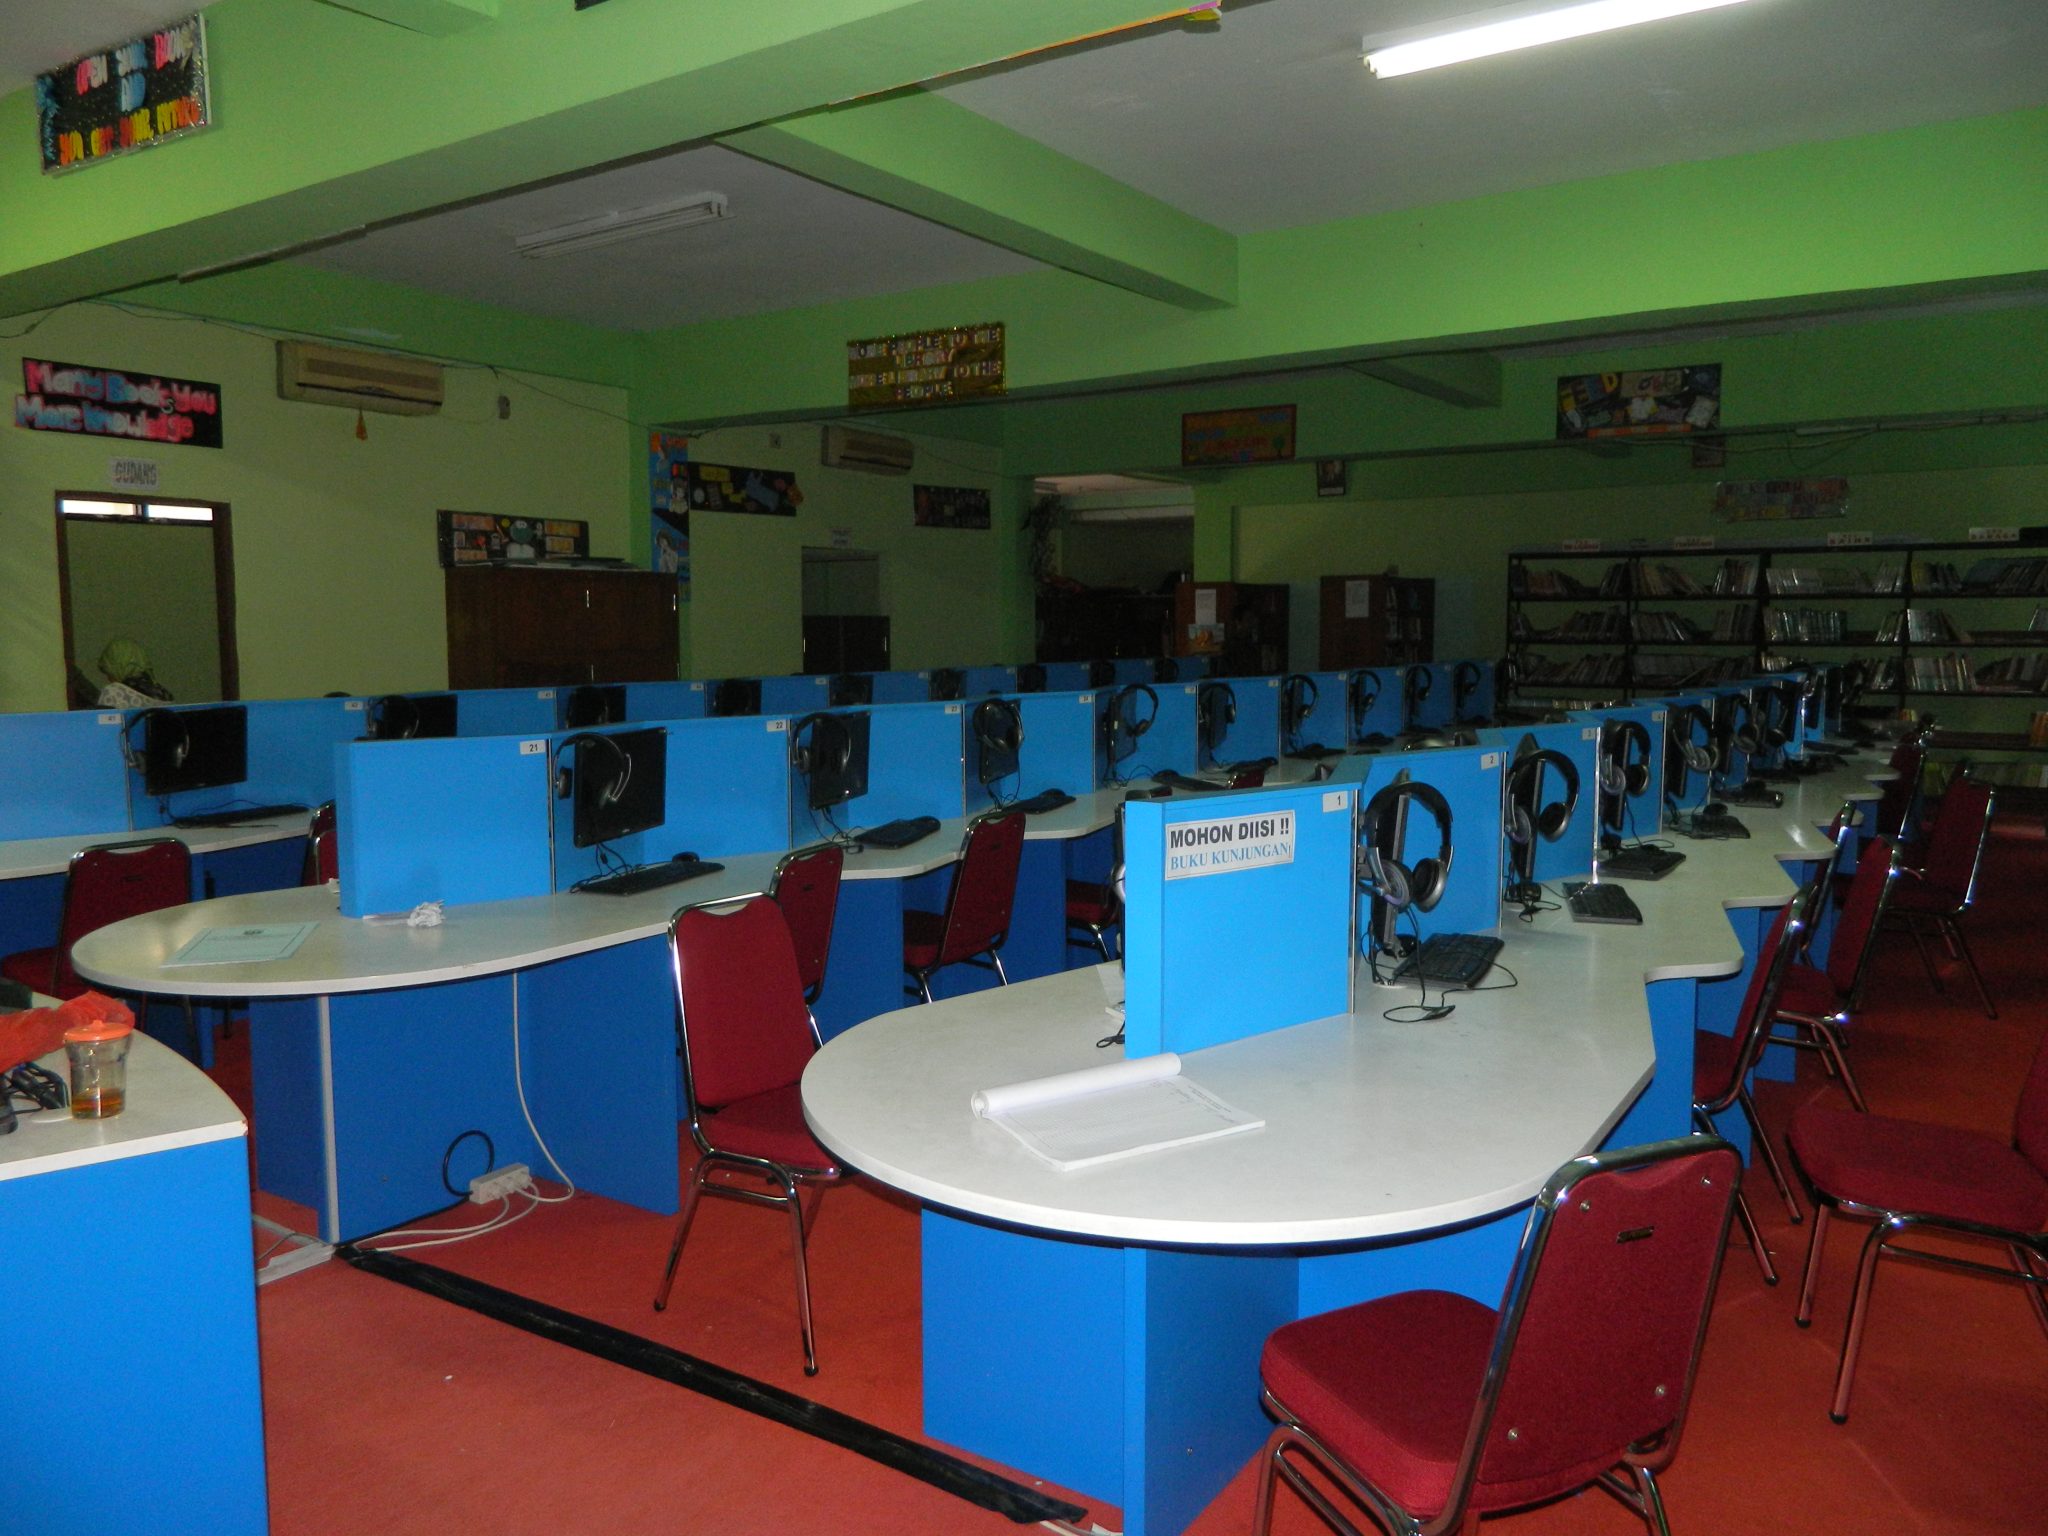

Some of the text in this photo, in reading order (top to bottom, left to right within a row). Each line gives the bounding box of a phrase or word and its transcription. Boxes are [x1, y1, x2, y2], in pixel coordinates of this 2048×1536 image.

[951, 333, 969, 347] TO
[973, 328, 1001, 345] THE
[953, 364, 971, 378] TO
[975, 360, 1002, 377] THE
[775, 721, 784, 729] 22
[528, 743, 539, 752] 21
[1170, 817, 1289, 848] MOHON DIISI !!
[1170, 842, 1290, 871] BUKU KUNJUNGAN
